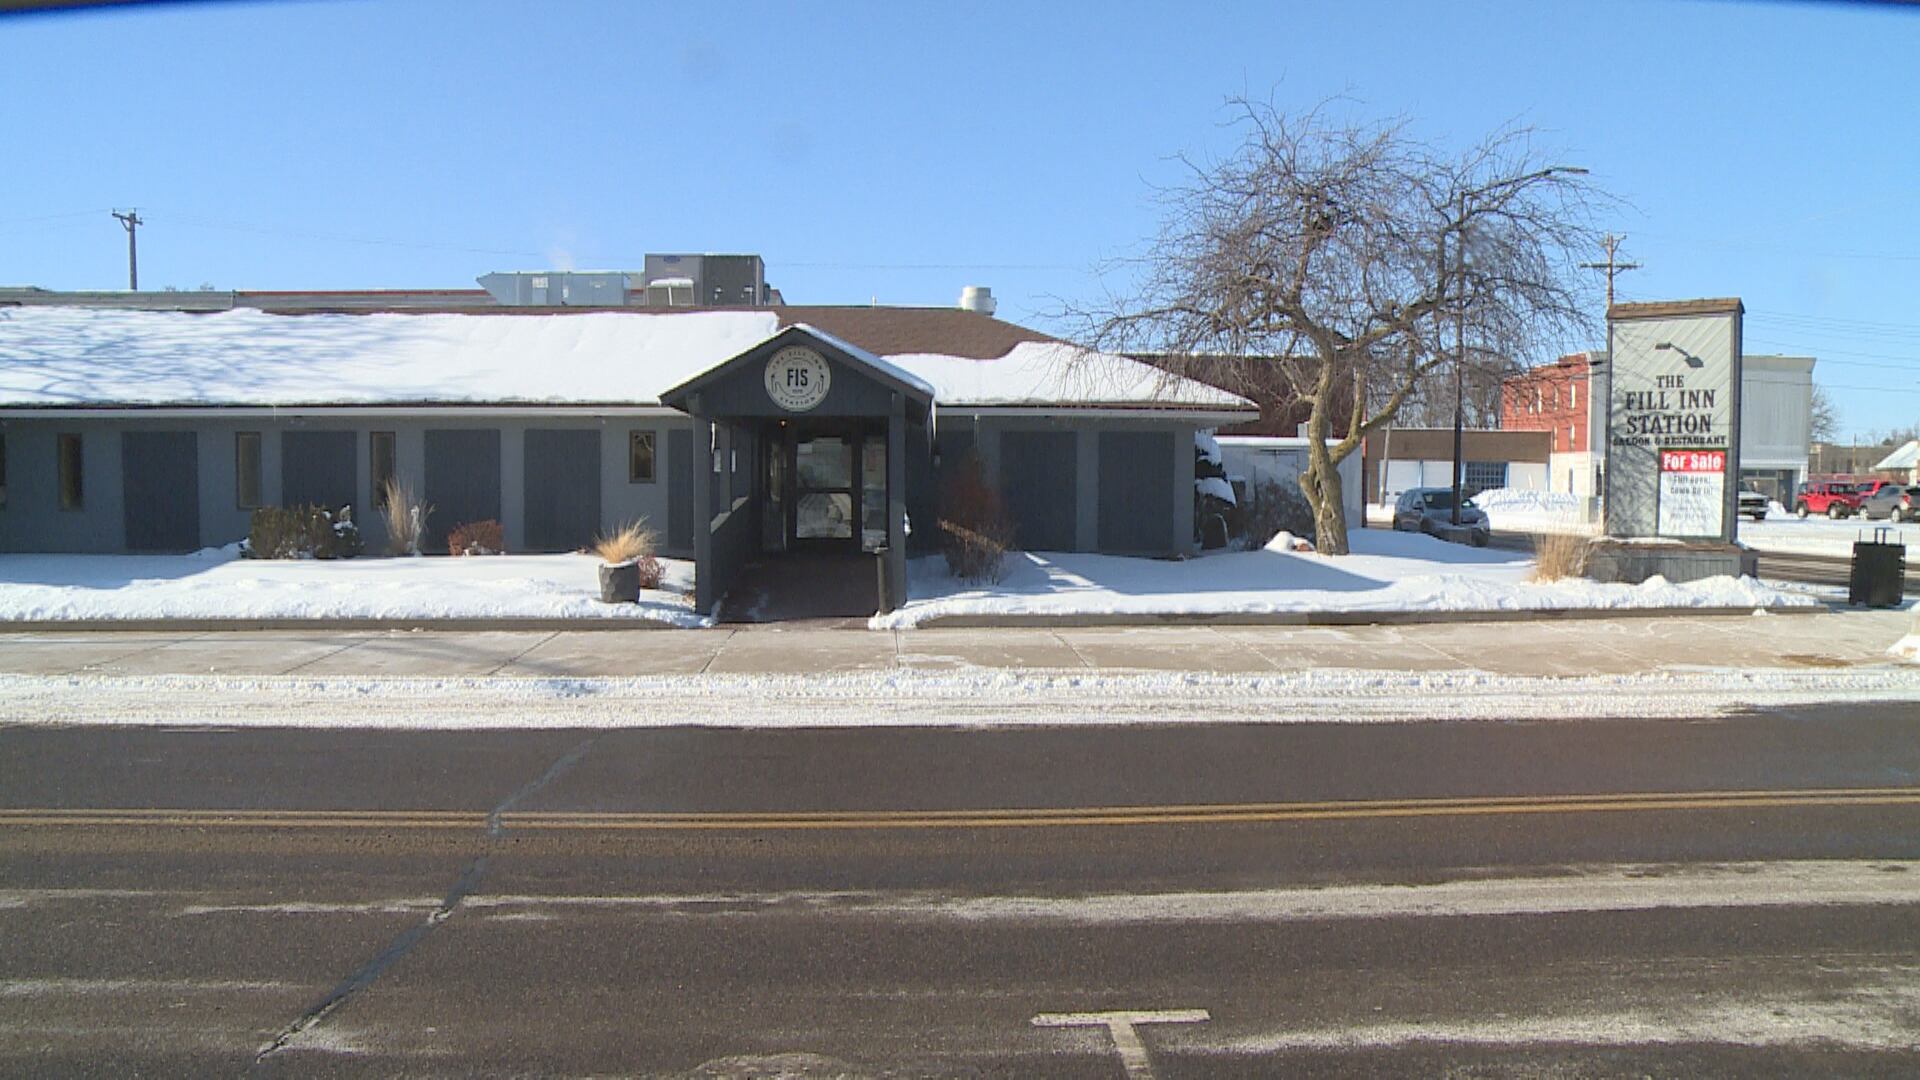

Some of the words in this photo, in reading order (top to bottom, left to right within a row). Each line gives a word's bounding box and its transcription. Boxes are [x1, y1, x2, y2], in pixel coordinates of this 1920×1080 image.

[787, 368, 808, 387] FIS
[1656, 375, 1684, 388] THE
[1626, 391, 1670, 410] FILL
[1679, 389, 1716, 409] INN
[1627, 414, 1712, 434] STATION
[1613, 437, 1650, 446] SALOON
[1664, 436, 1726, 447] RESTAURANT
[1663, 453, 1687, 470] For
[1690, 453, 1721, 470] Sale
